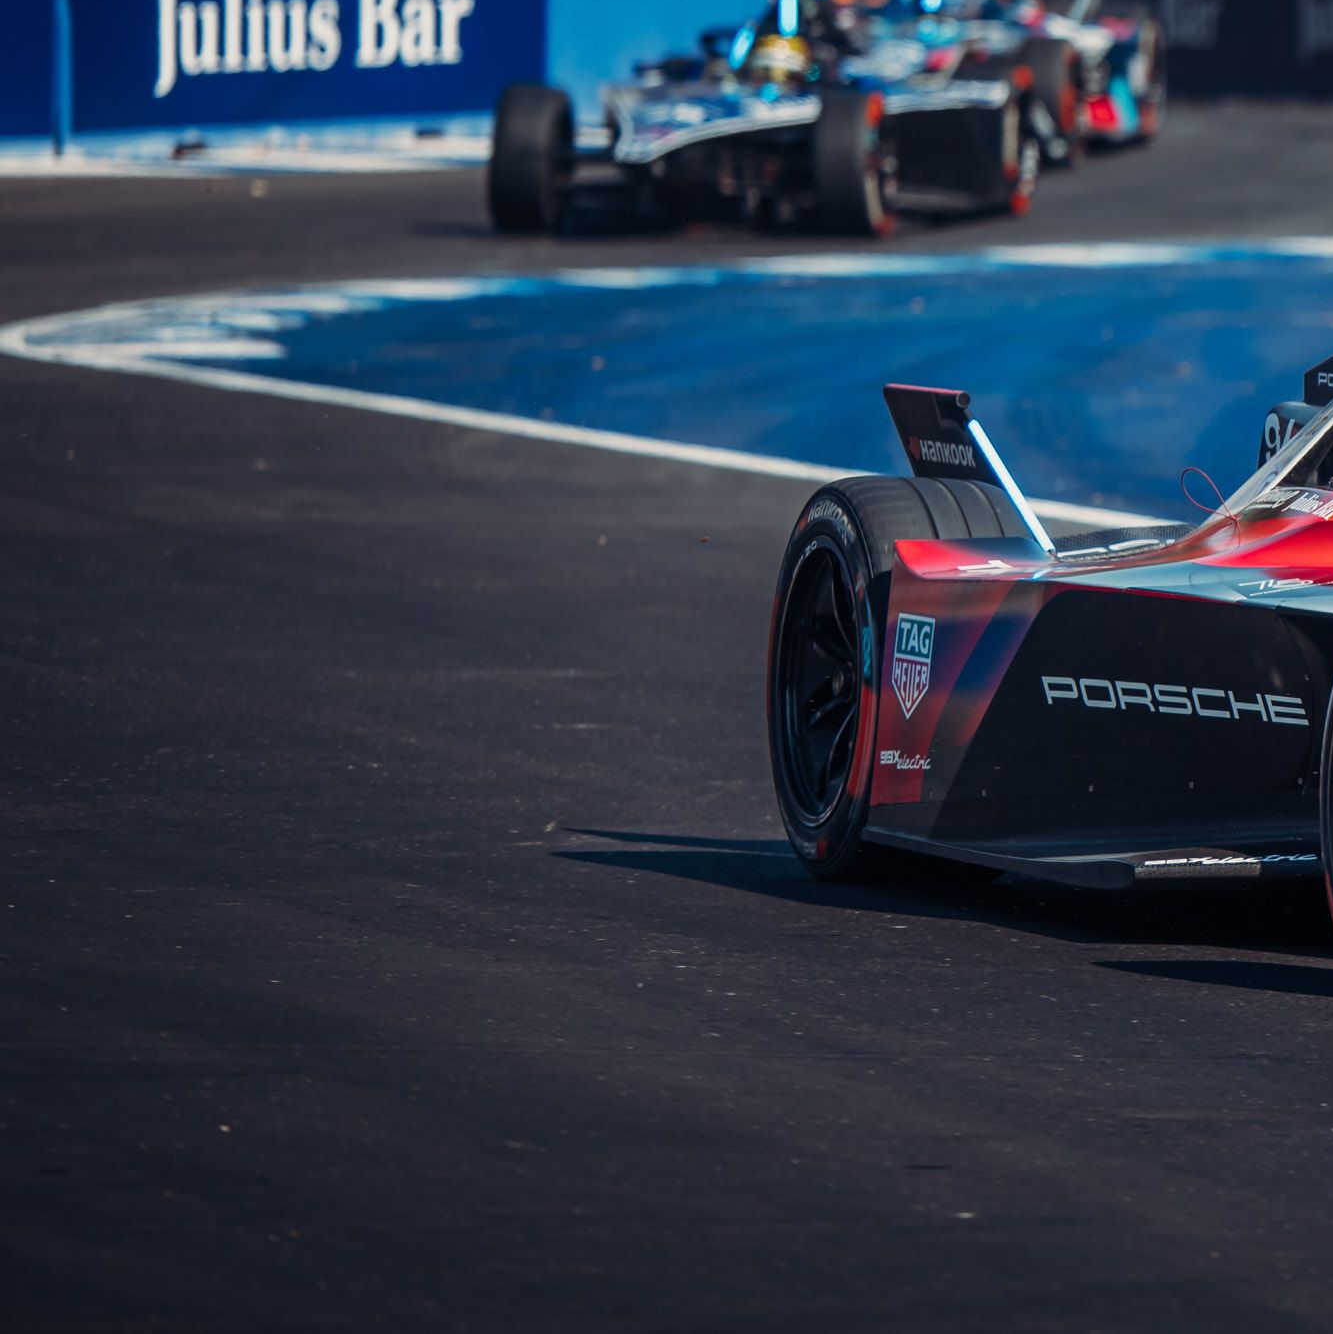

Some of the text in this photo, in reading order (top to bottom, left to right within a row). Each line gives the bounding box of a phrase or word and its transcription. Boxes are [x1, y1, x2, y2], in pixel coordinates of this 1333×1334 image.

[900, 621, 932, 655] TAG
[893, 660, 929, 709] HEUER
[1041, 675, 1310, 726] PORSCHE
